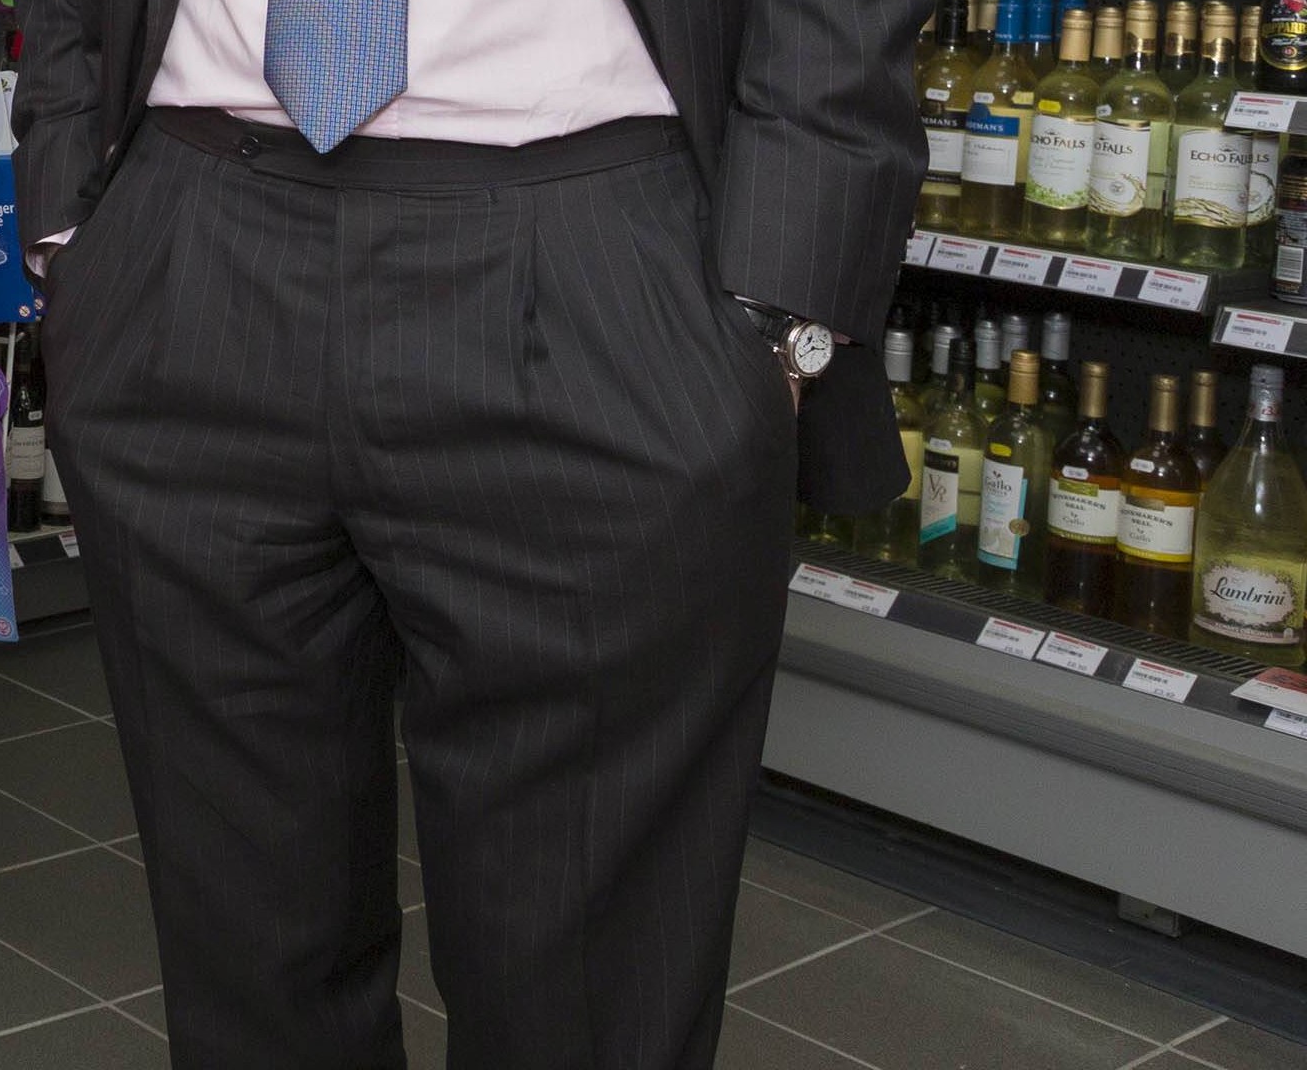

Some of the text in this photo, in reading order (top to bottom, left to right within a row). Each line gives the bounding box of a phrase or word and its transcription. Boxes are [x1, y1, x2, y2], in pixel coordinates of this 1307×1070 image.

[1054, 137, 1085, 148] FALLS
[1103, 142, 1133, 154] FALLS
[1191, 151, 1227, 162] ECHO
[1210, 577, 1287, 605] Lambrini
